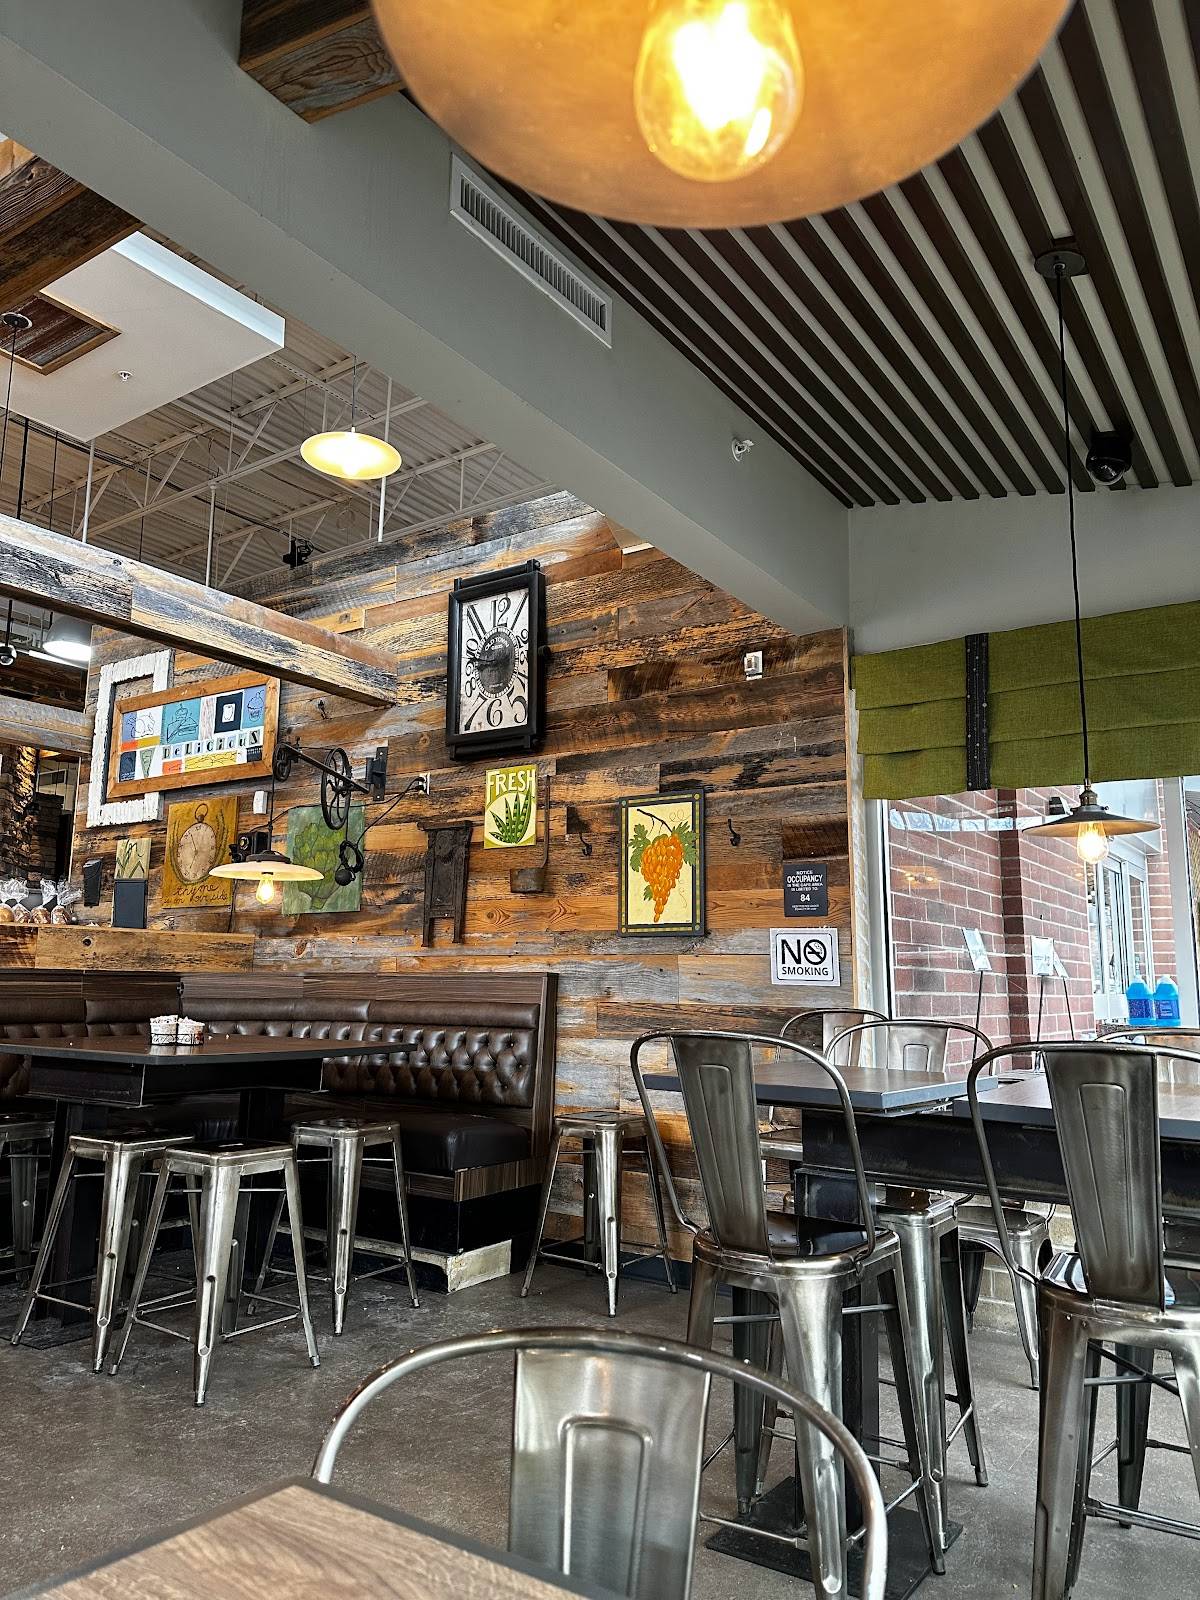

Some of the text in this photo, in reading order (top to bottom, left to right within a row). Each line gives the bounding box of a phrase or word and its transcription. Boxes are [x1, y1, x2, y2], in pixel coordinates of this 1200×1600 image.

[490, 596, 511, 628] 12
[486, 698, 503, 728] 6
[506, 685, 528, 724] 5
[486, 768, 536, 806] FRESH
[787, 874, 823, 884] OCCUPANCY
[800, 893, 810, 902] 84
[781, 938, 827, 966] NO
[781, 966, 829, 976] SMOKING
